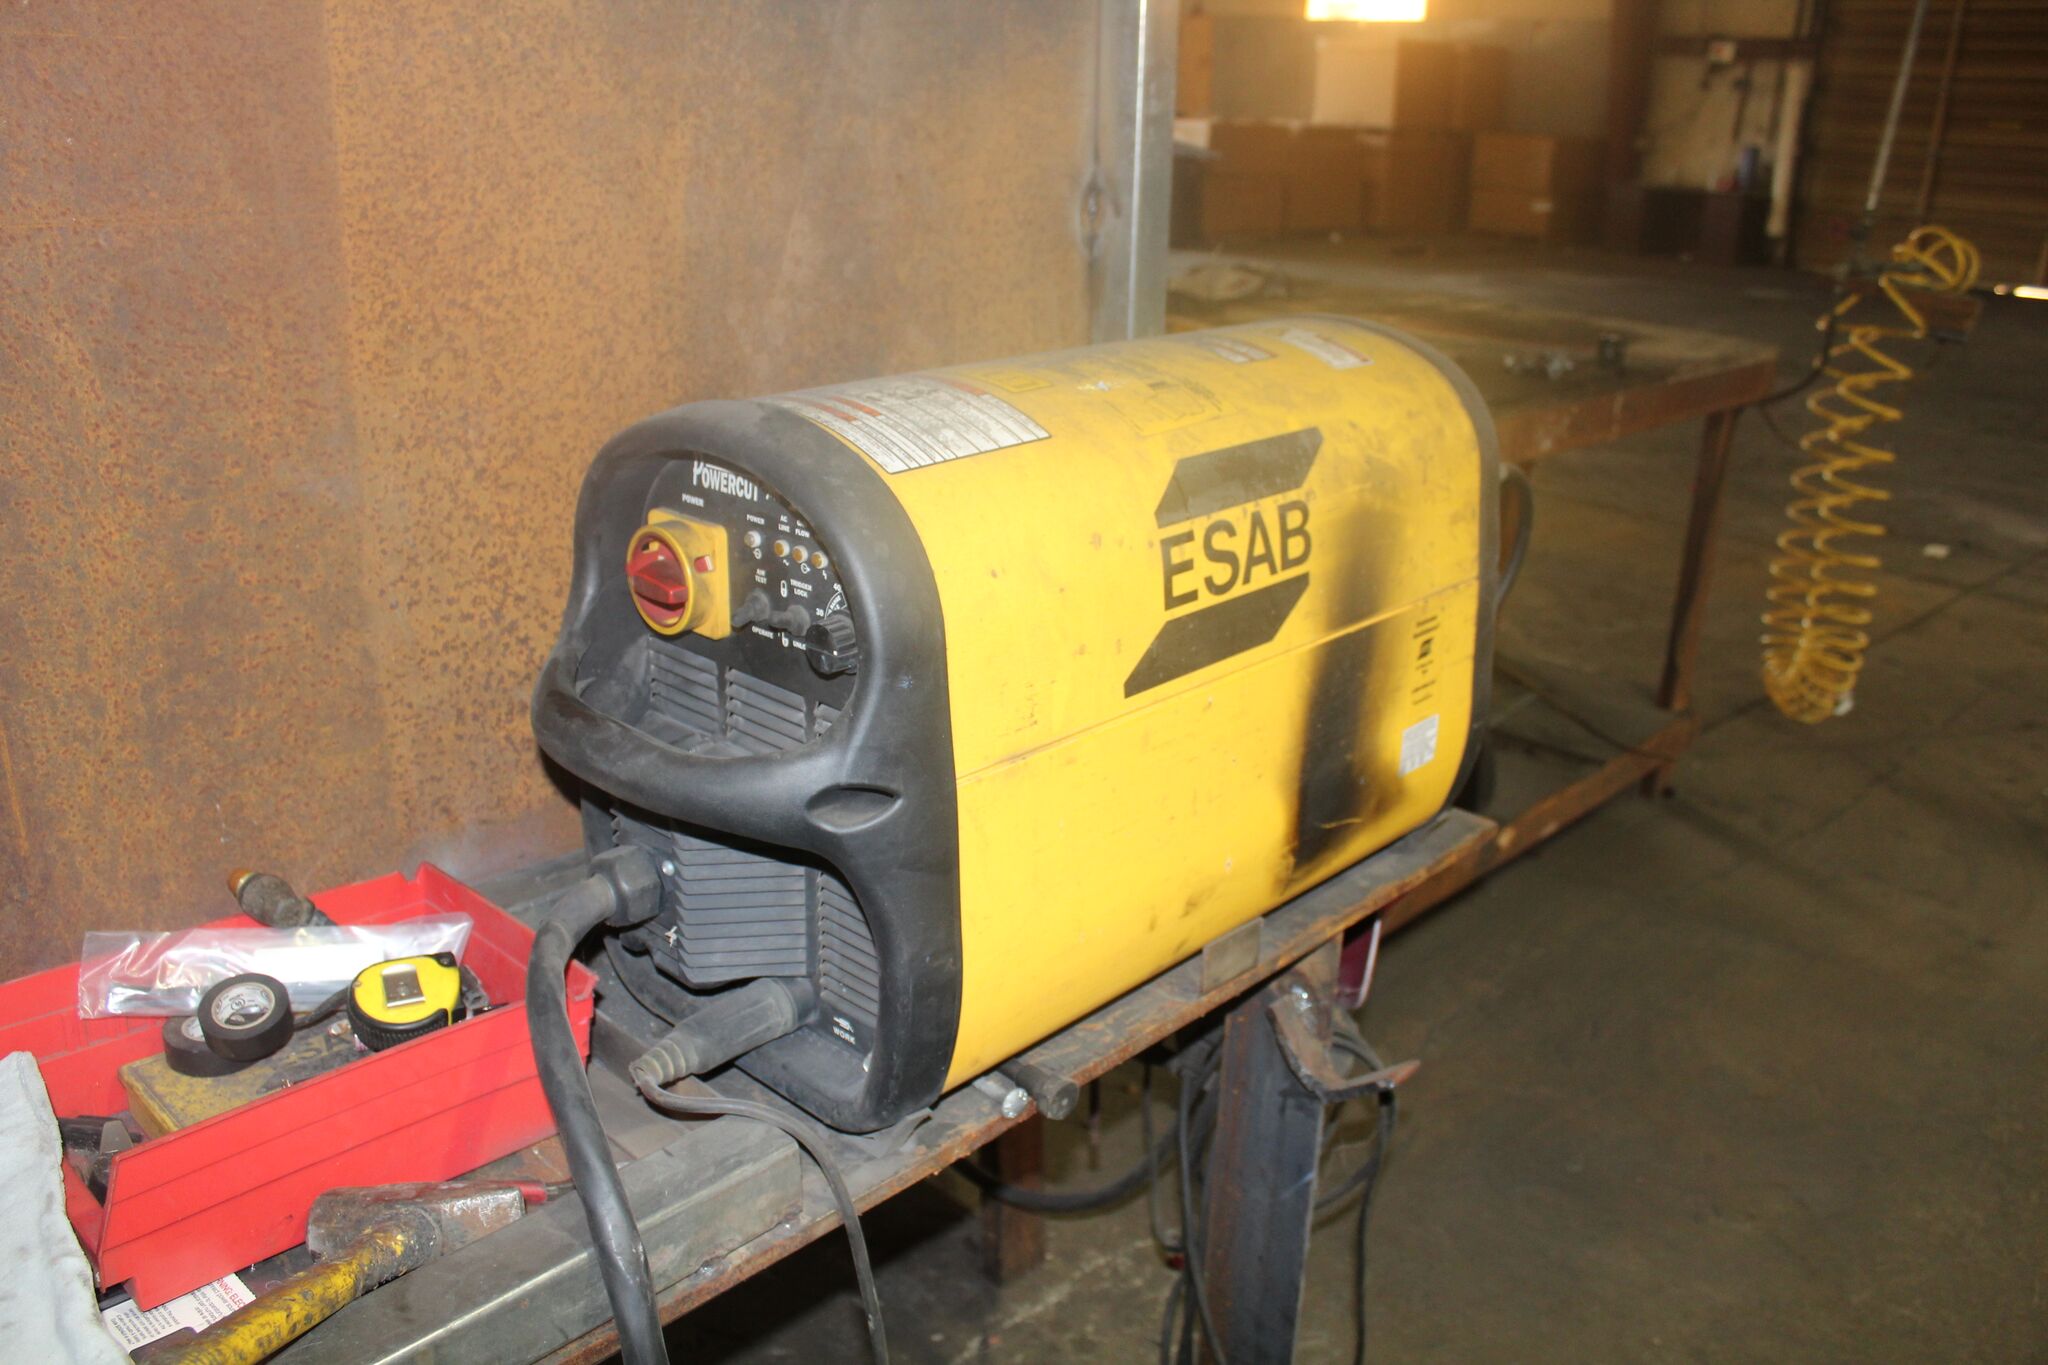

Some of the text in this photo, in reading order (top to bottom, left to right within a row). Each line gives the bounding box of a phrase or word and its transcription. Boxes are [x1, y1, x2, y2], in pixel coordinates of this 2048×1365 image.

[681, 493, 704, 507] POWER
[746, 514, 765, 525] POWER
[1160, 500, 1312, 611] ESAB
[793, 588, 808, 598] LOCK
[832, 1025, 856, 1045] WORK
